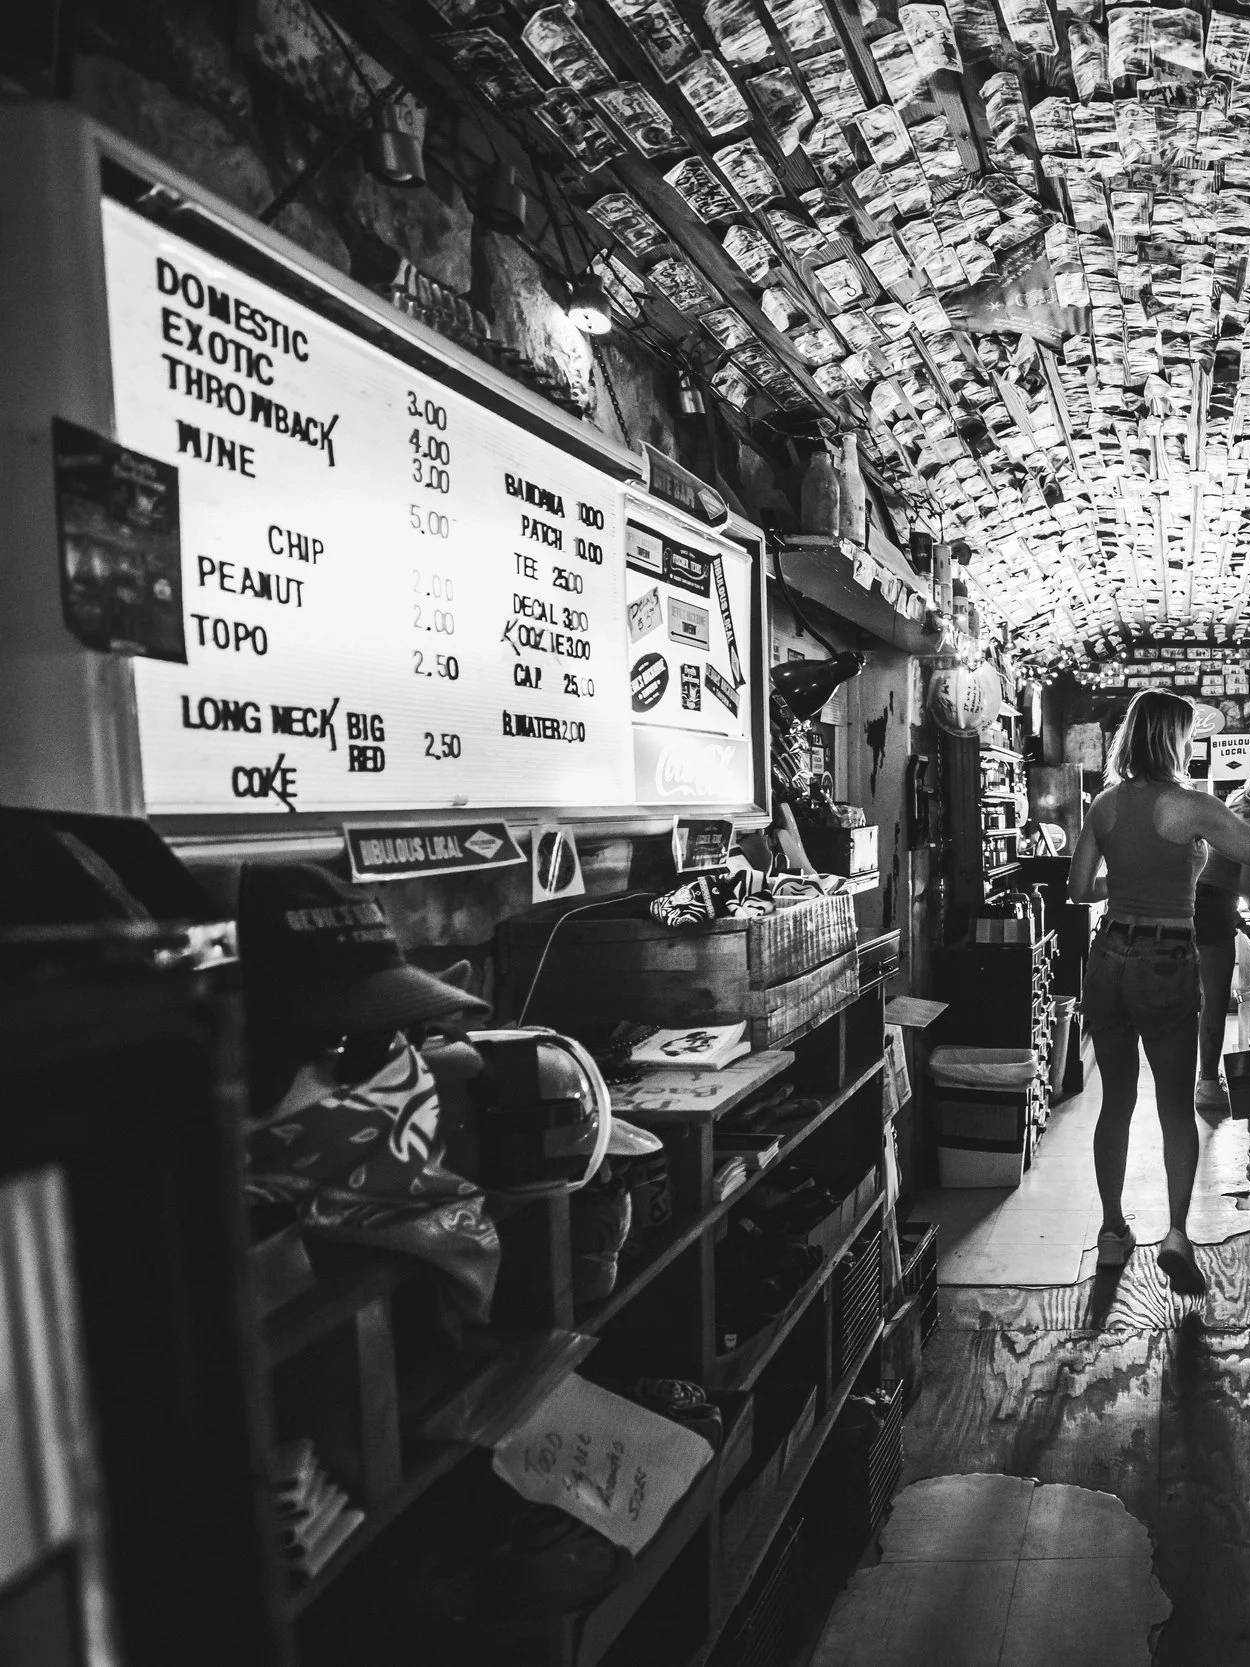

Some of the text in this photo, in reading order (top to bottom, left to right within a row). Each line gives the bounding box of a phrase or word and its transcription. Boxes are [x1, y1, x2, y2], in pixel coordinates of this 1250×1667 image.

[157, 257, 309, 362] DOMESTIC
[161, 307, 274, 386] EXOTIC
[161, 353, 339, 467] THROWBACK
[407, 390, 447, 431] 3.00
[176, 419, 256, 478] WINE
[409, 429, 450, 466] 4.00
[412, 458, 450, 494] 3.00
[410, 504, 450, 538] 5.00
[268, 525, 324, 564] CHIP
[521, 514, 603, 565] PATCH 10.00
[197, 555, 304, 607] PEANUT
[411, 568, 454, 601] 2.00
[513, 552, 538, 581] TEE
[412, 604, 455, 635] 2.00
[513, 592, 558, 625] DECAL
[190, 614, 268, 655] TOPO
[413, 650, 459, 680] 2.50
[513, 663, 542, 690] CAP
[181, 695, 340, 751] LONG NECK
[347, 712, 386, 742] BIG
[347, 745, 385, 772] RED
[424, 732, 461, 760] 2.50
[1220, 748, 1247, 756] LOCAL
[232, 753, 297, 811] COKE
